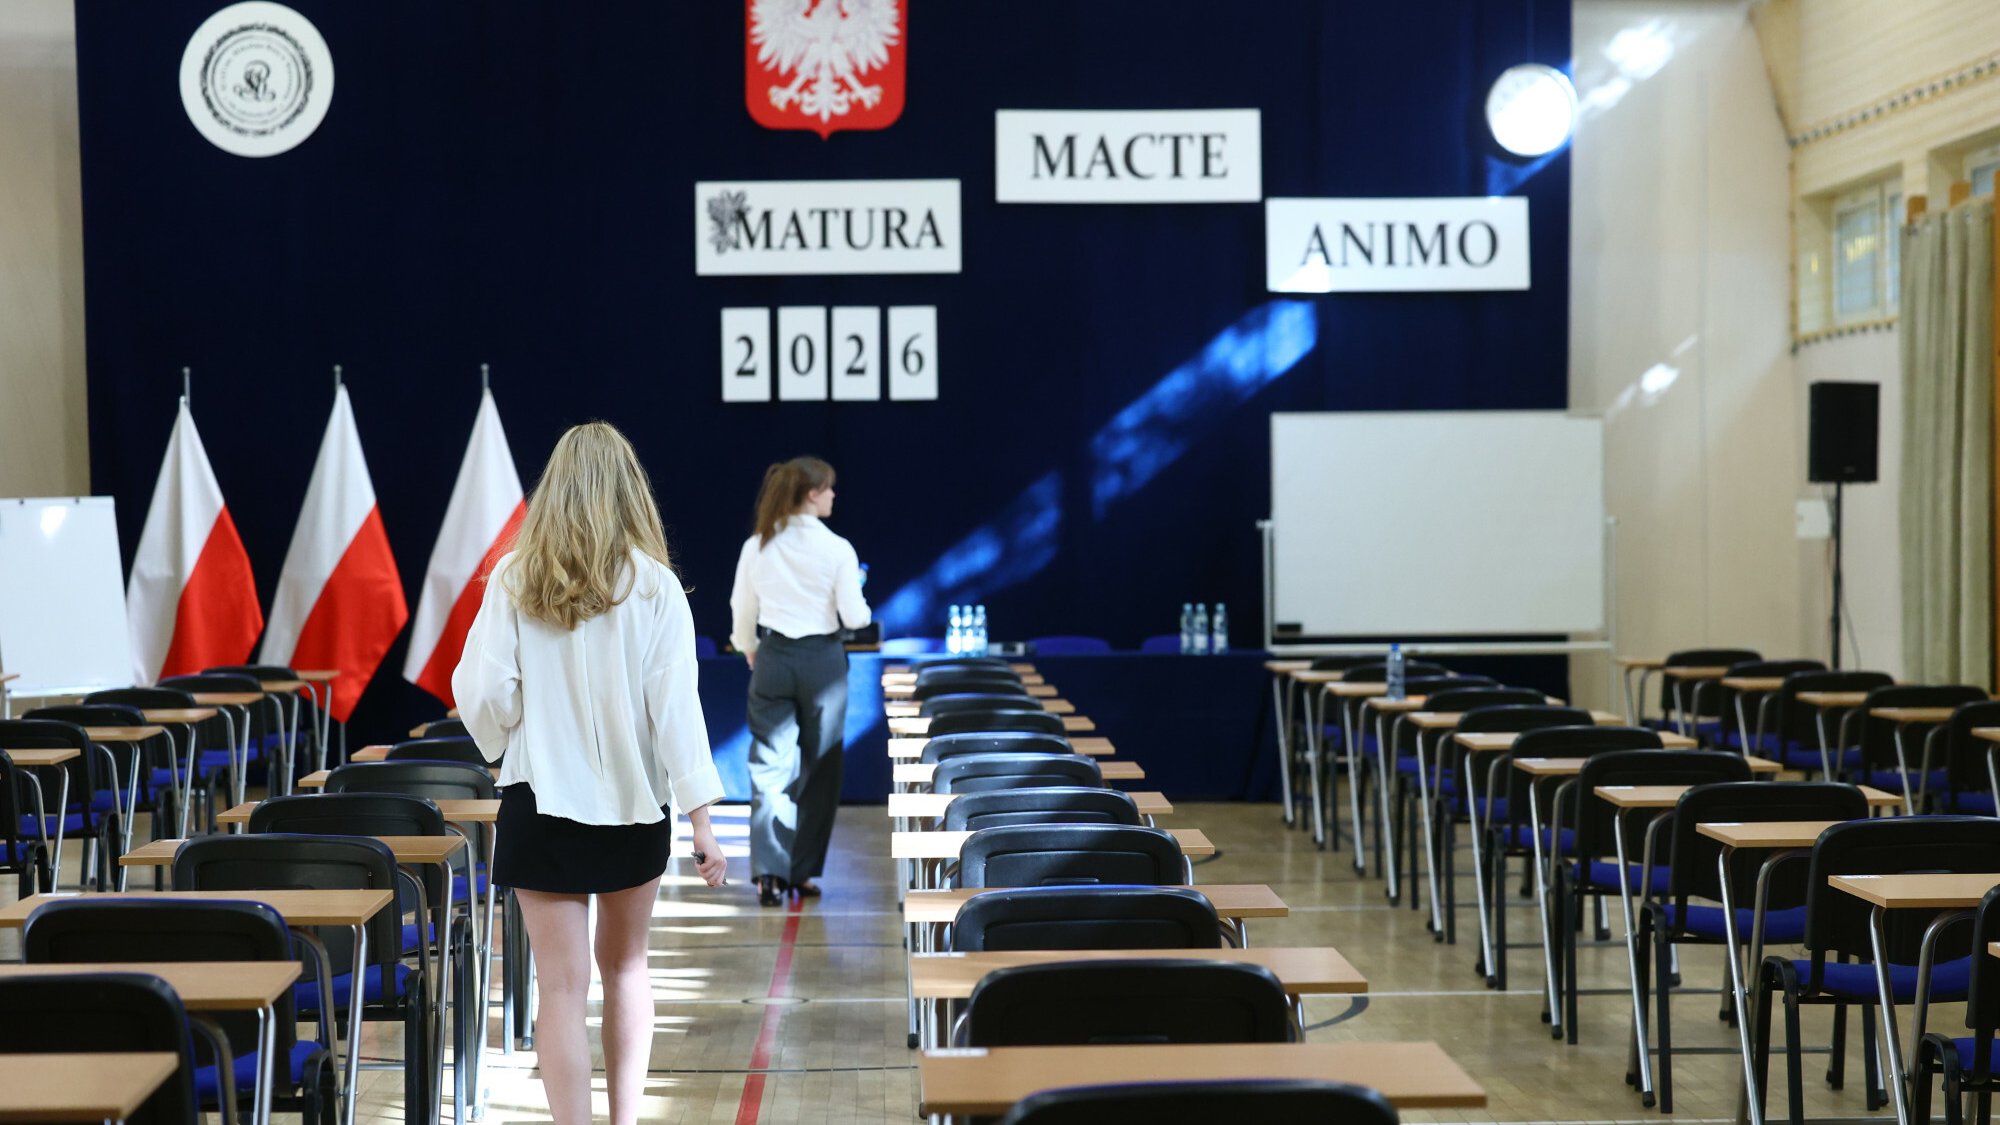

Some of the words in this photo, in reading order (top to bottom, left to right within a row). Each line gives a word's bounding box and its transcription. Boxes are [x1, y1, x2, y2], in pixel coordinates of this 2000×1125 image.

[1032, 133, 1228, 180] MACTE
[734, 207, 945, 251] MATURA
[1302, 220, 1499, 267] ANIMO
[735, 334, 926, 377] 2026
